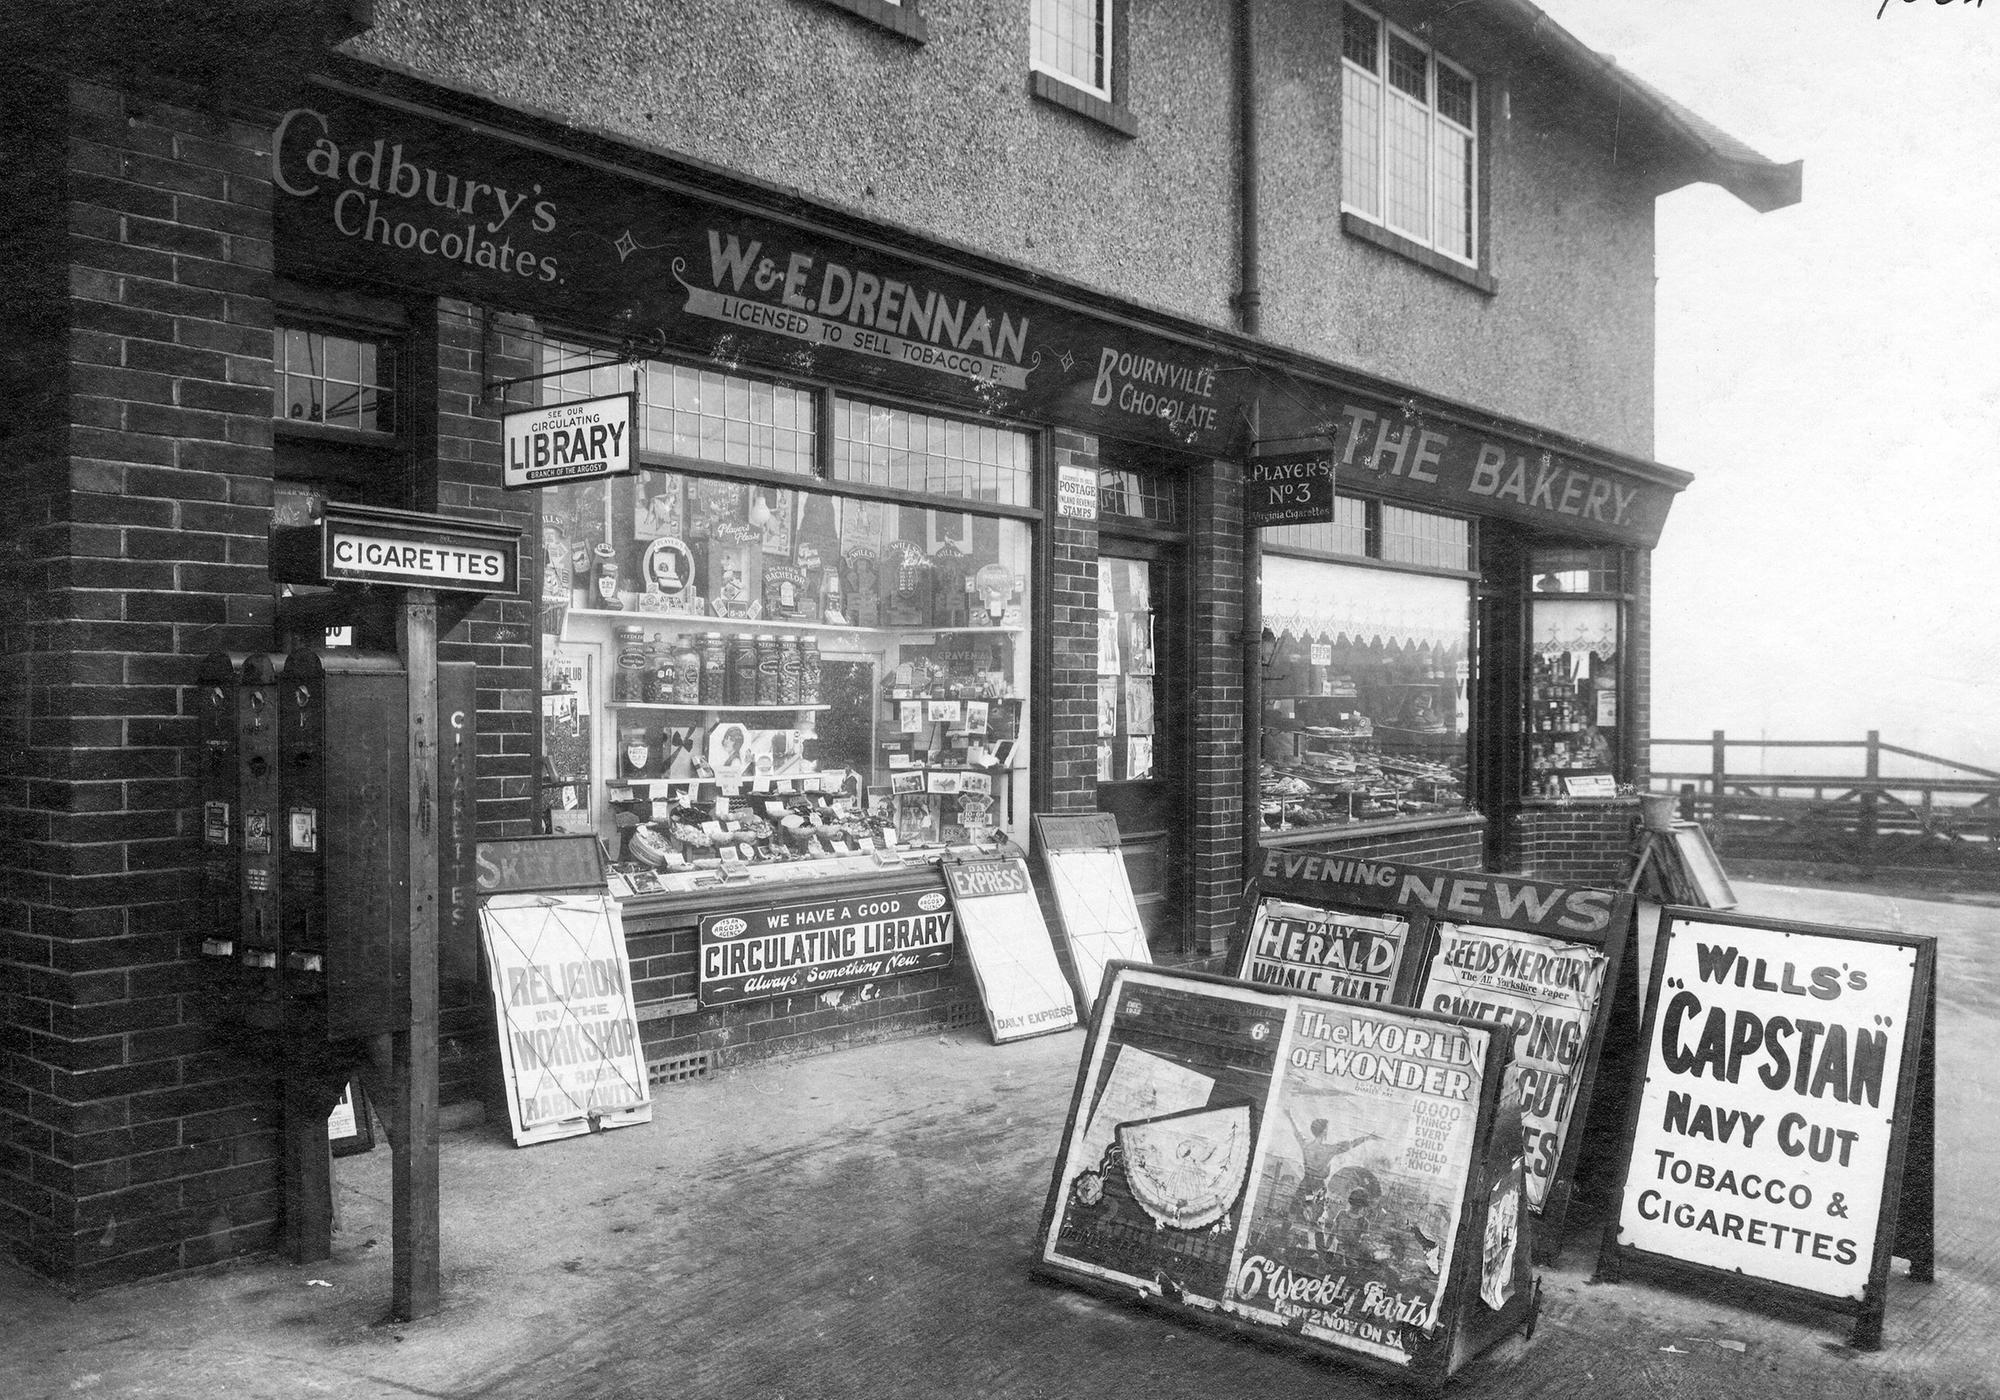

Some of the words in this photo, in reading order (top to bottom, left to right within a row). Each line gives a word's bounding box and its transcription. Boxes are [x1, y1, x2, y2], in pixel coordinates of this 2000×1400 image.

[272, 108, 557, 233] Cadbury's
[334, 190, 566, 285] Chocolates.
[721, 298, 808, 335] LICENSED
[822, 323, 843, 343] TO
[853, 332, 892, 355] SELL
[902, 343, 983, 375] TOBACCO
[1091, 347, 1216, 406] BOURNVILLE
[531, 413, 600, 432] CIRCULATING
[548, 410, 562, 418] SEE
[567, 406, 584, 416] OUR
[510, 420, 626, 471] LIBRARY
[1342, 404, 1448, 484] THE
[530, 470, 555, 479] BRANCH
[556, 468, 564, 476] OF
[565, 467, 576, 475] THE
[577, 463, 603, 473] ARGOSY
[1060, 480, 1096, 498] POSTAGE
[1295, 482, 1312, 503] 3
[1063, 505, 1092, 518] STAMPS
[735, 531, 760, 544] Please
[336, 540, 500, 577] CIGARETTES
[765, 571, 805, 585] BACHELOR
[952, 868, 1025, 896] EXPRESS
[967, 862, 1000, 874] DAILY
[1262, 851, 1397, 887] EVENING
[1398, 874, 1615, 934] NEWS
[714, 923, 745, 932] ARGOSY
[767, 914, 790, 929] WE
[796, 907, 835, 925] HAVE
[841, 907, 852, 919] A
[858, 900, 900, 917] GOOD
[1307, 922, 1356, 939] DAILY
[705, 927, 856, 979] CIRCULATING
[864, 913, 952, 955] LIBRARY
[1259, 920, 1396, 975] HERALD
[806, 960, 883, 982] Something
[885, 952, 920, 973] New.
[1443, 938, 1504, 975] LEEDS
[1500, 945, 1596, 993] MERCURY
[1696, 942, 1869, 1001] WILLS'S
[507, 957, 626, 1008] RELIGION
[1461, 971, 1478, 982] The
[1480, 974, 1493, 985] All
[1496, 977, 1538, 994] Yorkshire
[1542, 987, 1570, 1000] Paper
[536, 1007, 559, 1023] IN
[572, 1003, 610, 1017] THE
[997, 1012, 1025, 1030] DAILY
[1028, 1004, 1075, 1025] EXPRESS
[1127, 1000, 1143, 1009] DEC
[513, 1018, 638, 1072] WORKSHOP
[1300, 1008, 1346, 1043] The
[1348, 1016, 1473, 1066] WORLD
[575, 1064, 624, 1085] RABBI
[1291, 1047, 1321, 1072] OF
[1321, 1048, 1474, 1102] WONDER
[1415, 1115, 1453, 1131] THINGS
[1415, 1127, 1450, 1142] EVERY
[1662, 1089, 1766, 1149] NAVY
[1777, 1111, 1860, 1168] CUT
[1405, 1147, 1448, 1164] SHOULD
[1415, 1139, 1444, 1152] CHILD
[1408, 1159, 1442, 1175] KNOW
[1654, 1148, 1813, 1210] TOBACCO
[1826, 1191, 1850, 1220] &
[1637, 1188, 1858, 1266] CIGARETTES
[1264, 1264, 1361, 1319] Weekly
[1361, 1280, 1429, 1328] Parts
[1273, 1298, 1310, 1320] PART
[1309, 1308, 1323, 1324] 2
[1322, 1311, 1359, 1334] NOW
[1359, 1322, 1383, 1343] ON
